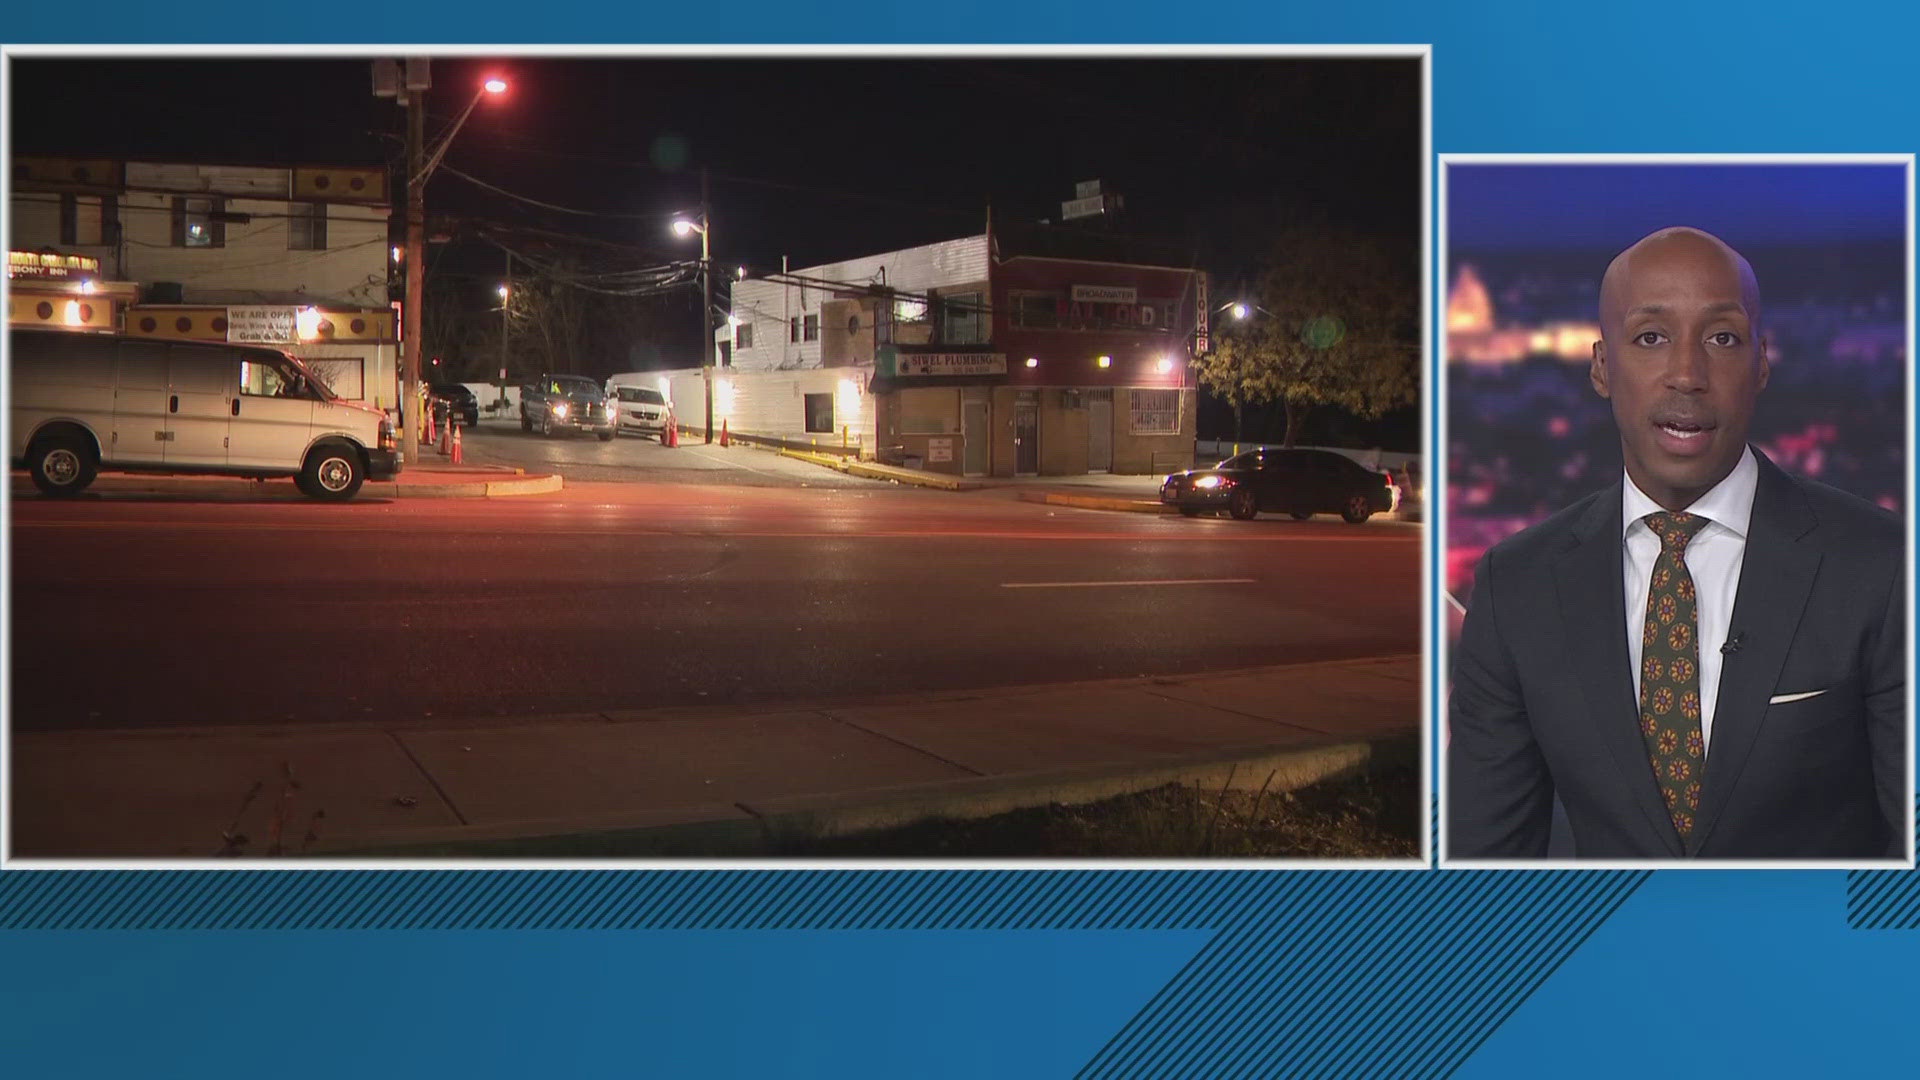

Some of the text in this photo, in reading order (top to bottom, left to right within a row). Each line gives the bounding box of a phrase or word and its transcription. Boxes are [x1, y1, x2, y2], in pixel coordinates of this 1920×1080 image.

[50, 267, 68, 276] INN
[231, 310, 247, 319] WE
[249, 310, 268, 319] ARE
[912, 354, 993, 366] SIWEL PLUMBING
